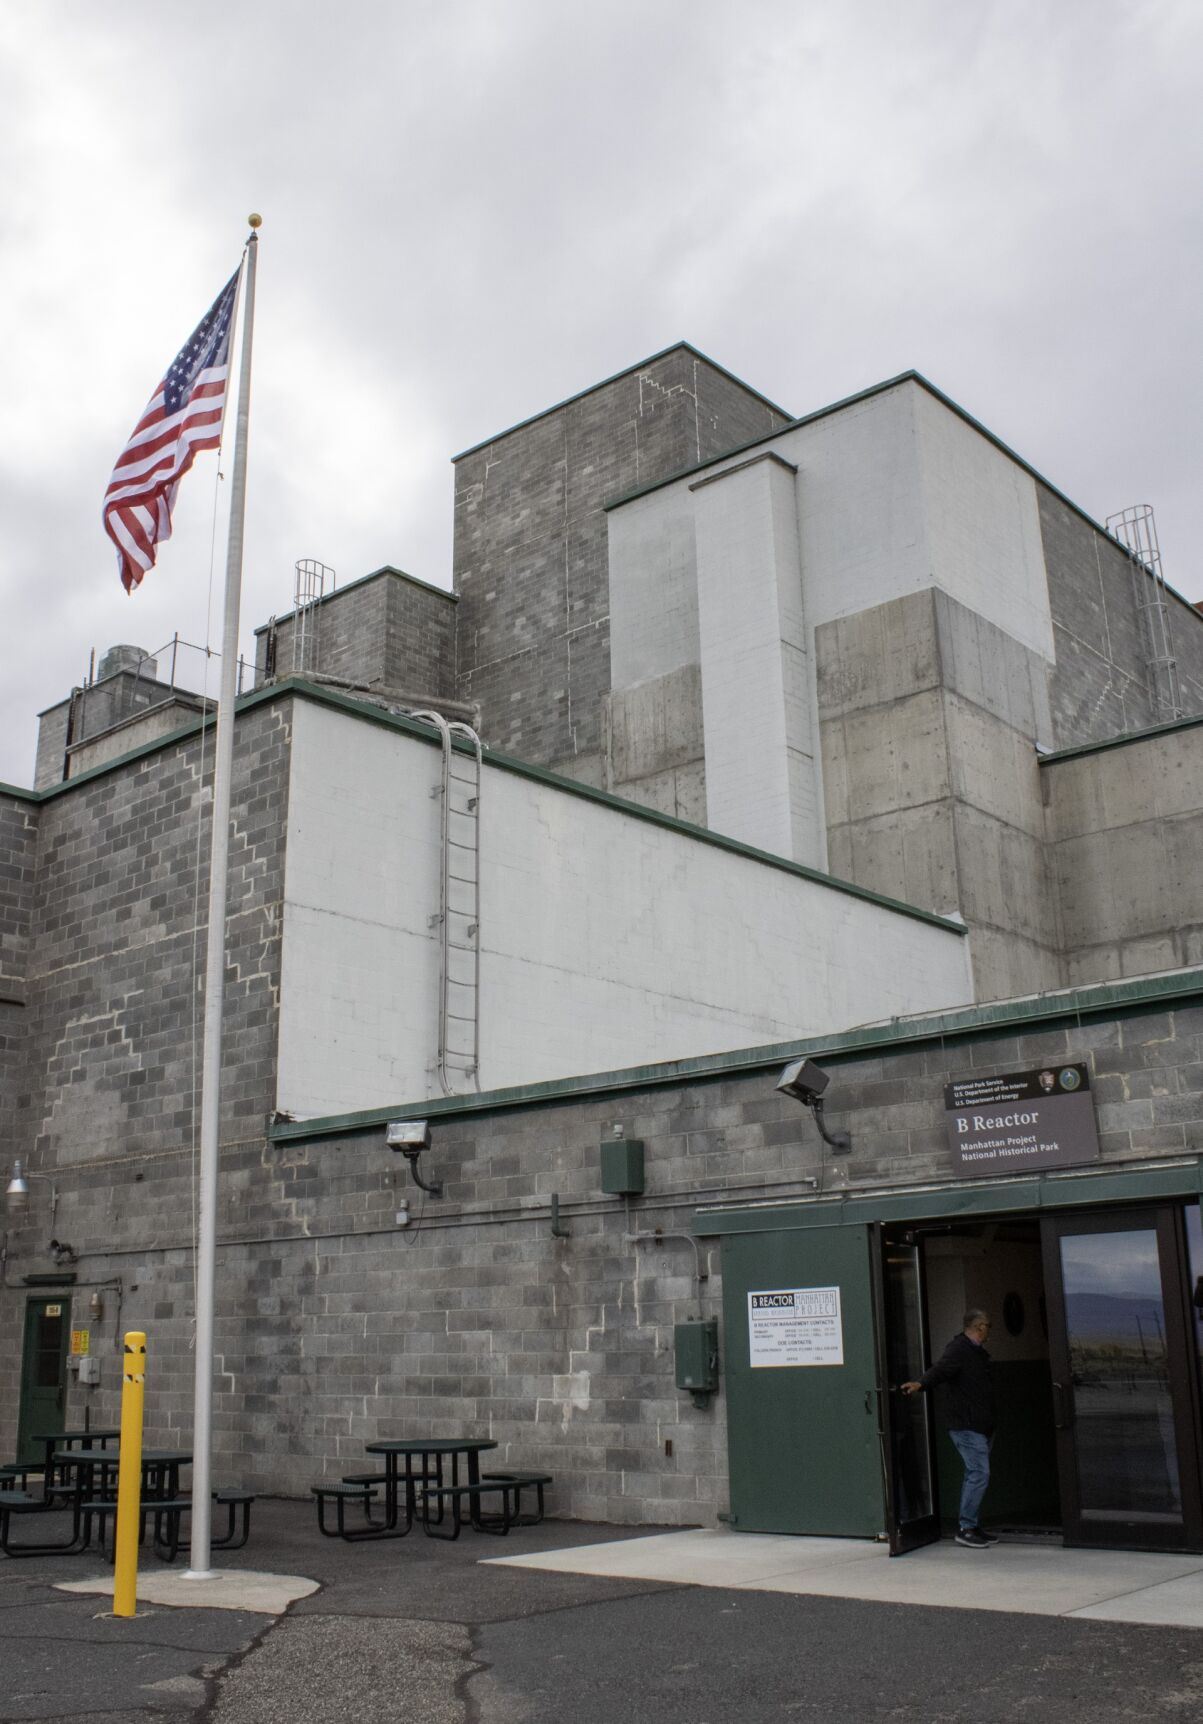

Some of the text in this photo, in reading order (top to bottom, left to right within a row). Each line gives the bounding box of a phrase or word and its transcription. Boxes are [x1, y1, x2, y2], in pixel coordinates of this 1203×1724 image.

[956, 1112, 1040, 1133] B Reactor
[960, 1135, 1036, 1151] Manhattan Project
[962, 1142, 1059, 1161] National Historical Park
[752, 1295, 794, 1307] B REACTOR
[796, 1293, 834, 1304] MANHATTAN
[796, 1304, 835, 1316] PROJECT
